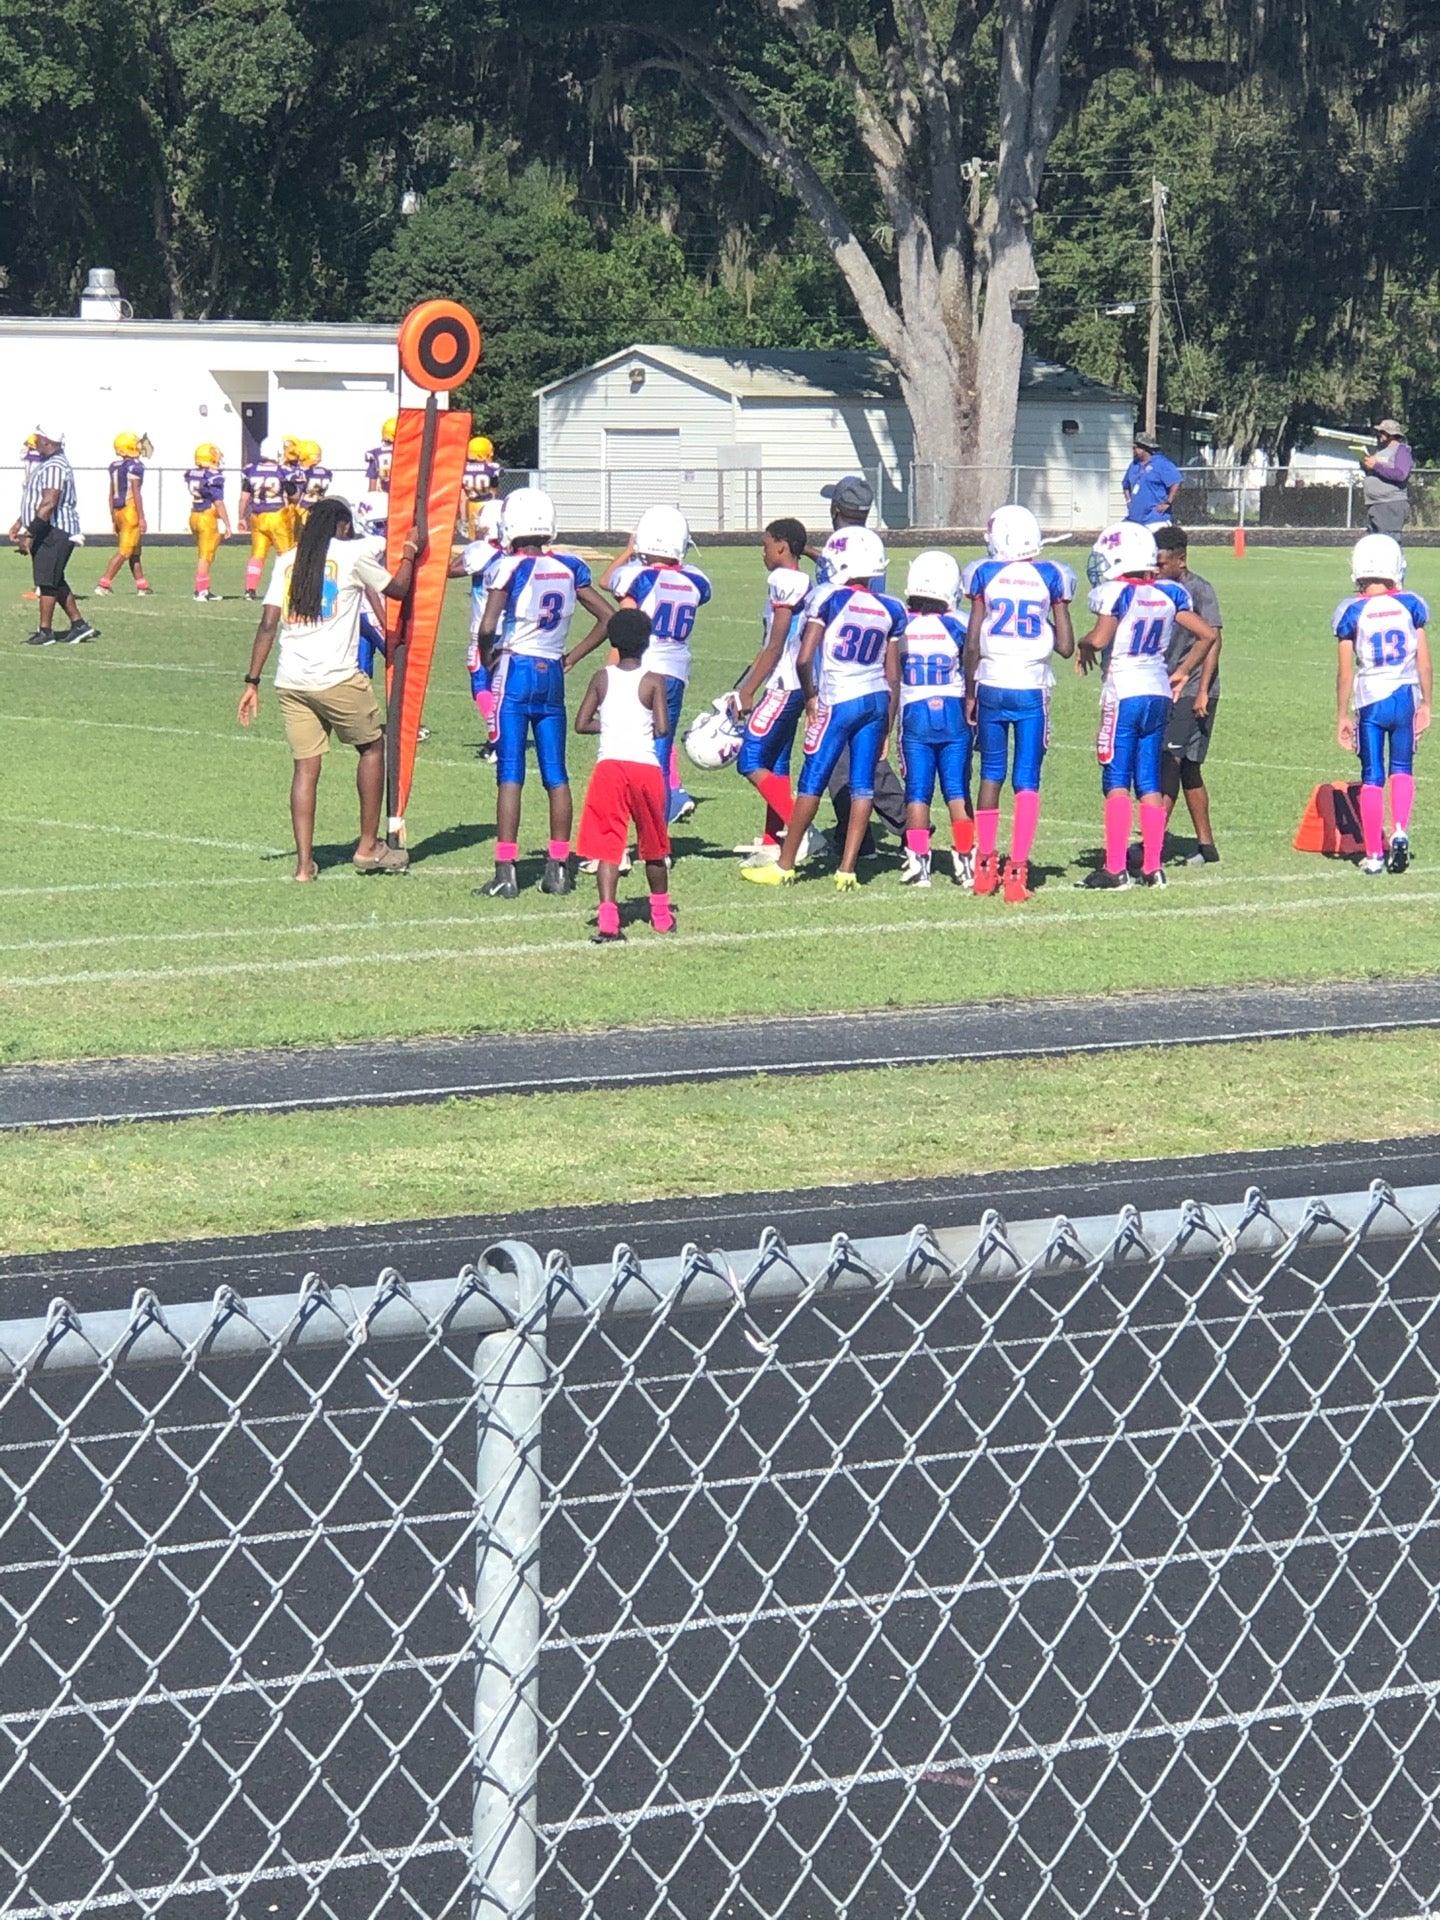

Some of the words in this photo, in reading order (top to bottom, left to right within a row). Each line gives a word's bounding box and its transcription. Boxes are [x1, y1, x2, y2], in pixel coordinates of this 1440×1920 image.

[250, 476, 283, 504] 72
[539, 590, 566, 633] 3
[652, 600, 697, 643] 46
[989, 597, 1043, 640] 25
[832, 622, 887, 666] 30
[1127, 616, 1167, 657] 14
[1368, 629, 1409, 668] 13
